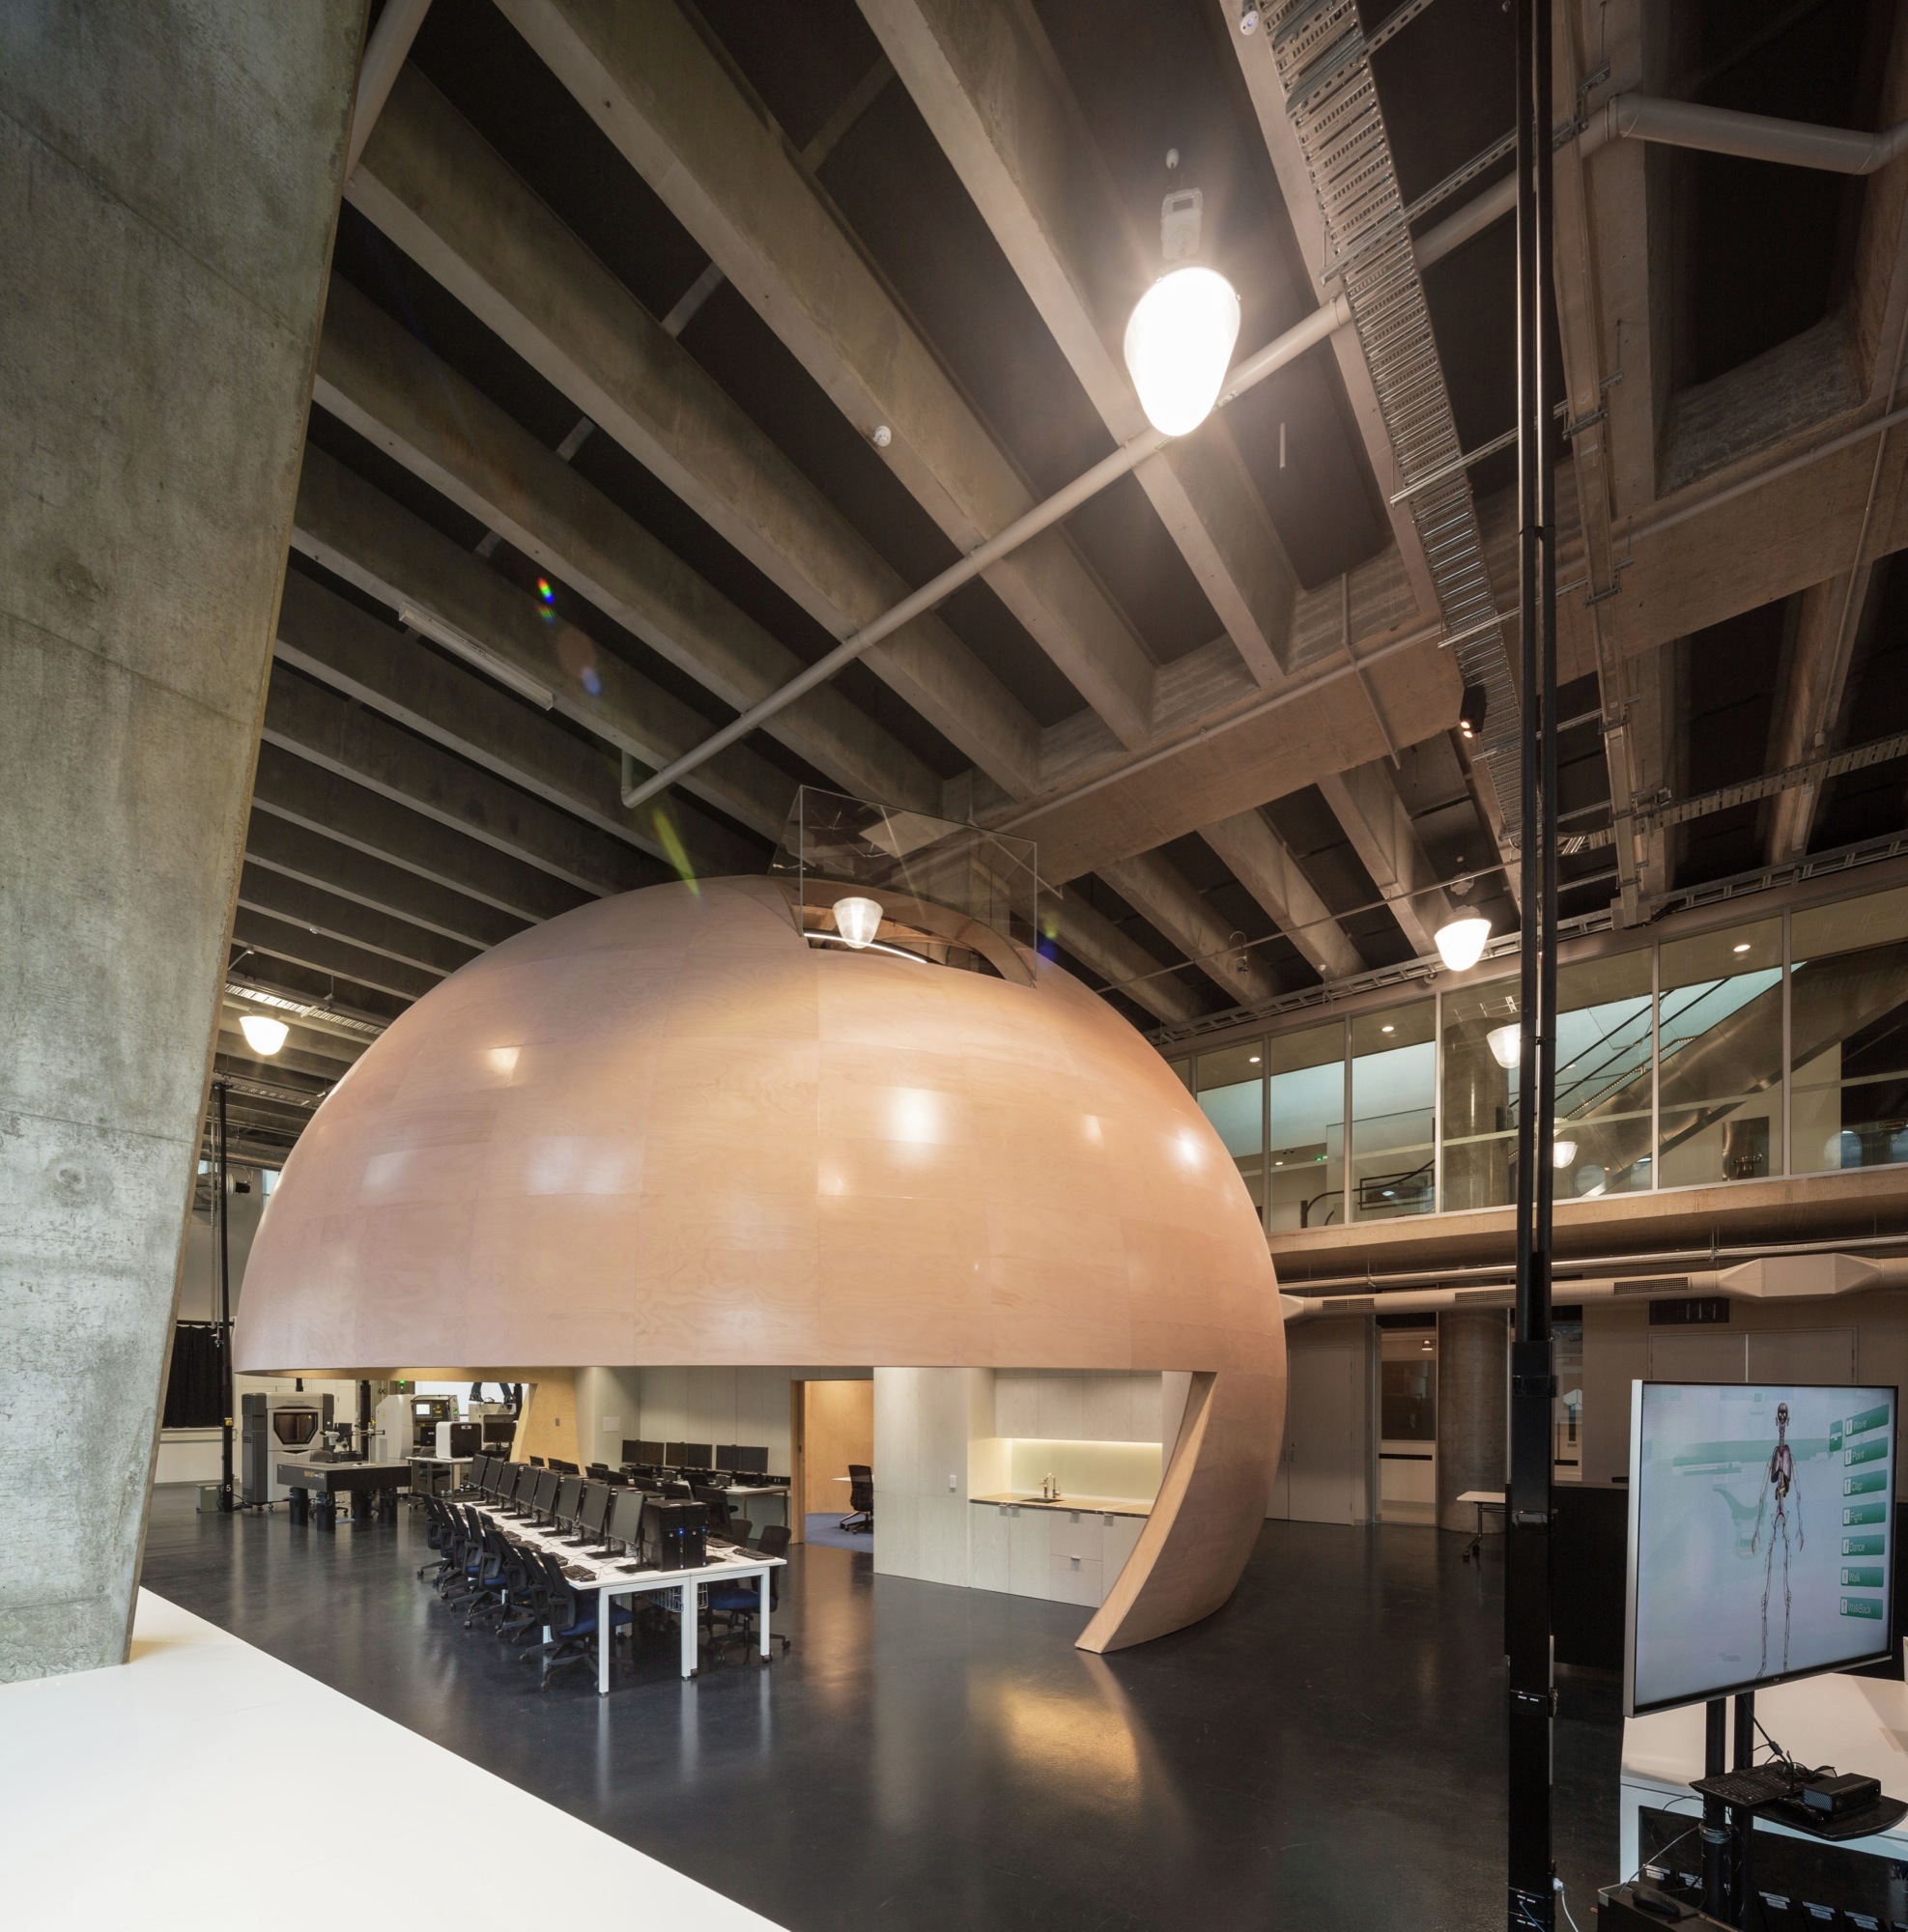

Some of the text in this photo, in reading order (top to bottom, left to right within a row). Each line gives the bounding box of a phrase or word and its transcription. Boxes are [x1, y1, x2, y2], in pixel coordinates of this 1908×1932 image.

[1853, 1420, 1867, 1431] Wave
[1852, 1450, 1865, 1460] Point
[1851, 1482, 1863, 1492] Clap
[1850, 1512, 1863, 1523] Fight
[1849, 1542, 1865, 1552] Dance
[1848, 1573, 1861, 1582] Walk
[1847, 1604, 1872, 1614] WalkBack
